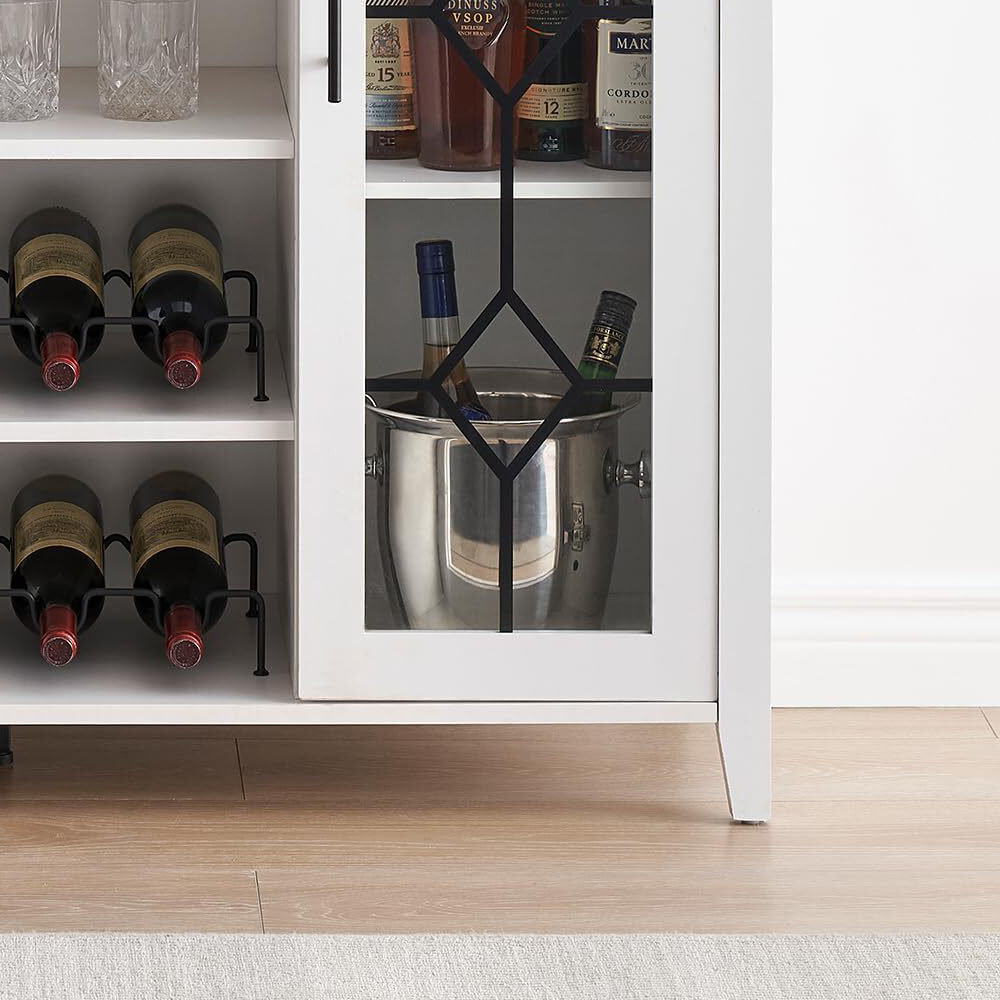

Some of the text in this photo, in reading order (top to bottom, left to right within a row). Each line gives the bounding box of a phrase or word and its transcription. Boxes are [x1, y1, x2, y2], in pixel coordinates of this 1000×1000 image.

[448, 0, 497, 10] DINUSS
[452, 12, 493, 23] VSOP
[616, 37, 651, 50] MAR
[377, 67, 395, 82] 15
[543, 101, 560, 115] 12
